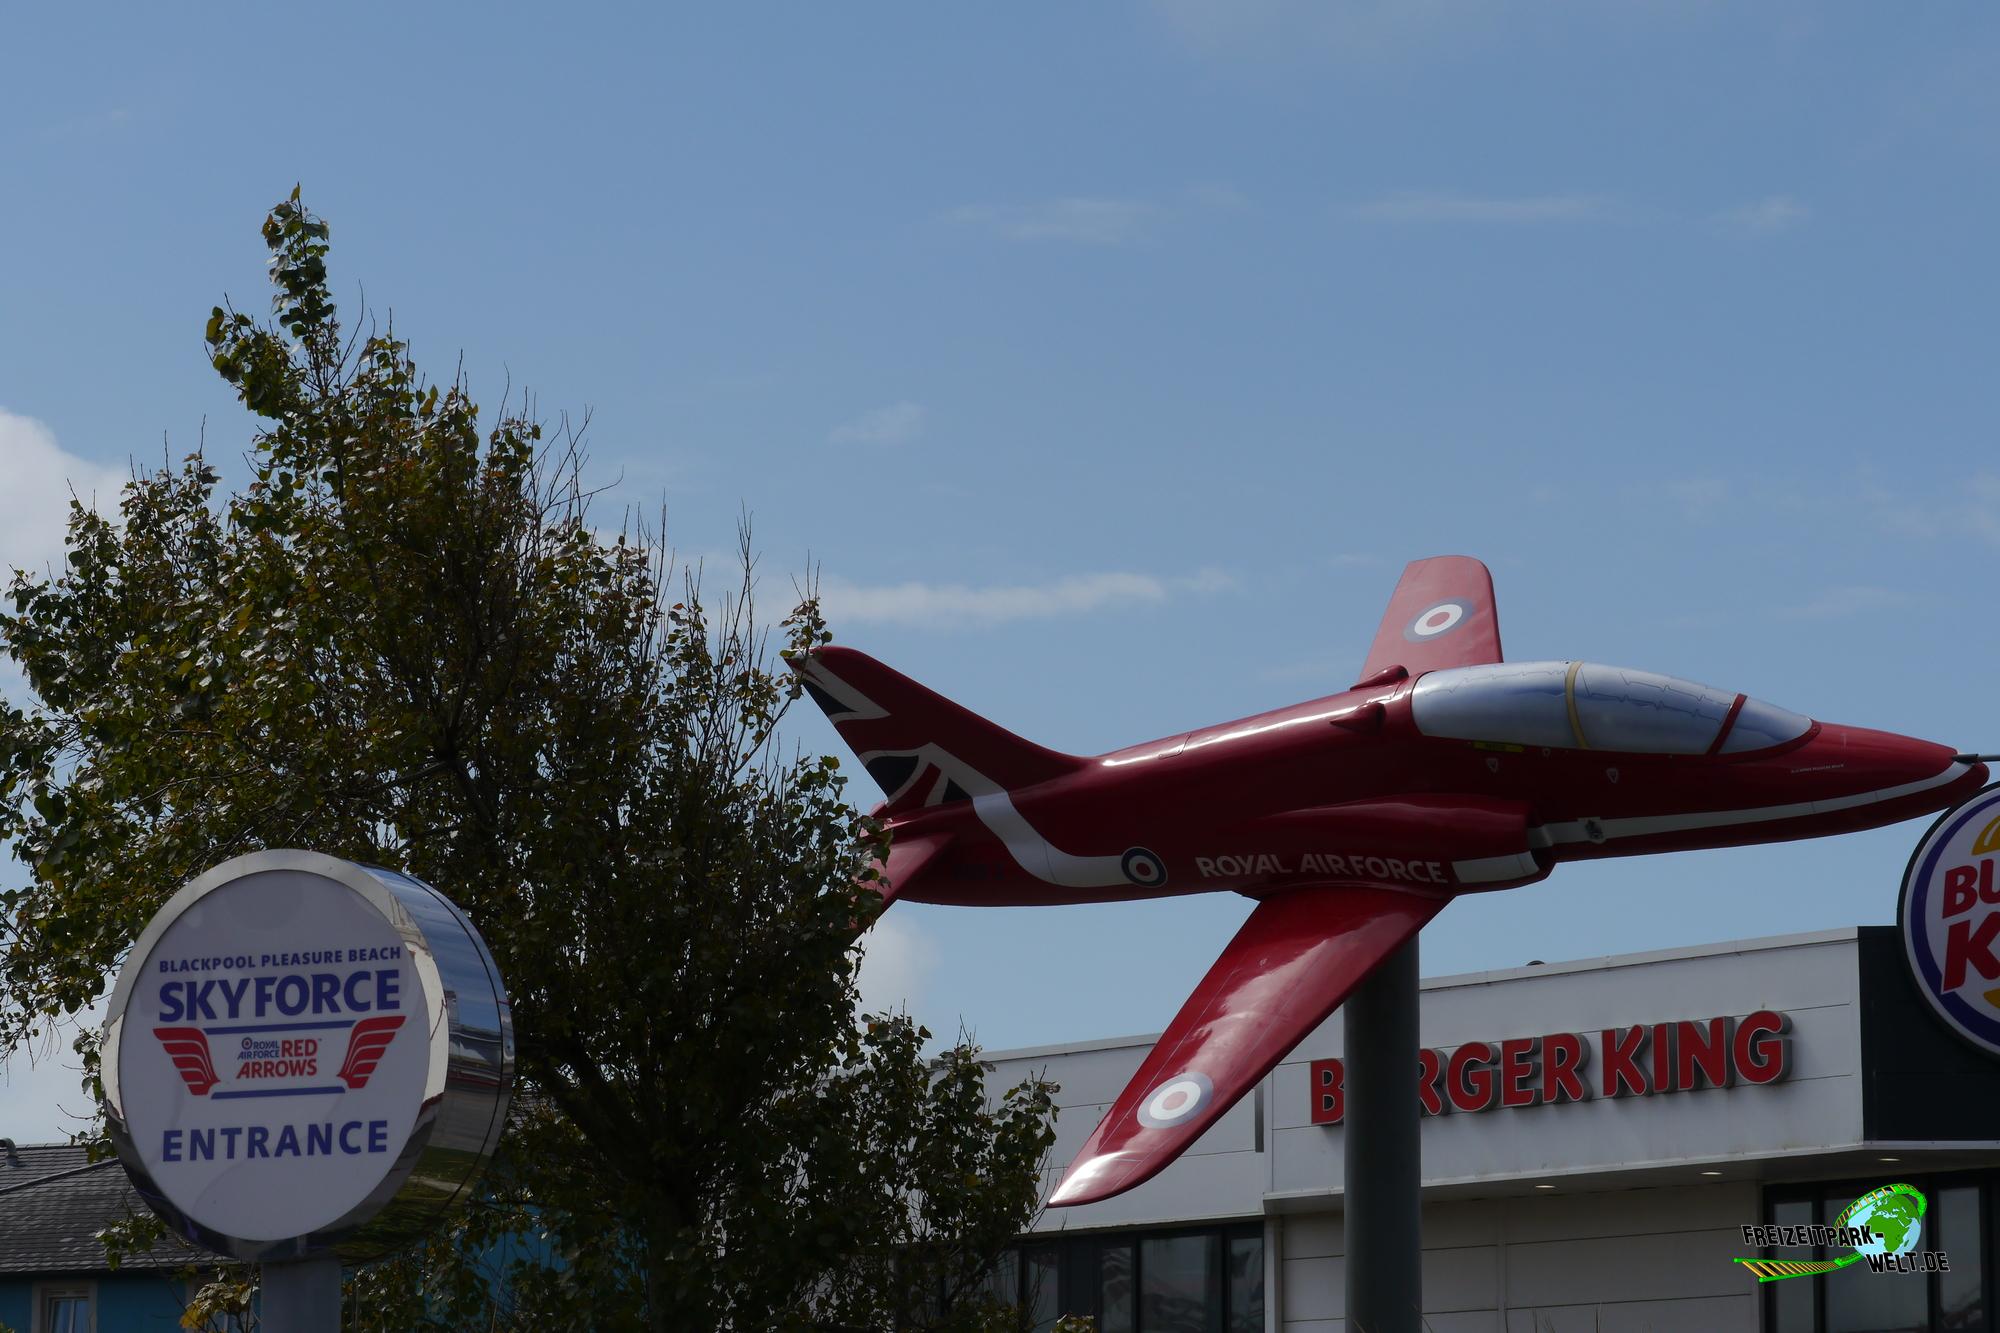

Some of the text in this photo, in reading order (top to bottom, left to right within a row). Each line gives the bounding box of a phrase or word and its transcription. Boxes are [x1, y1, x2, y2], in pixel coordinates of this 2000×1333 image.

[1195, 853, 1449, 884] ROYAL AIR FORCE
[159, 946, 401, 973] BLACKPOOL PLEASURE BEACH
[159, 968, 401, 1022] SKYFORCE
[237, 1049, 280, 1060] AIR FORCE
[253, 1038, 318, 1057] ROYAL RED
[236, 1058, 318, 1079] ARROWS
[1311, 1010, 1792, 1127] BRGER KING
[162, 1120, 388, 1162] ENTRANCE
